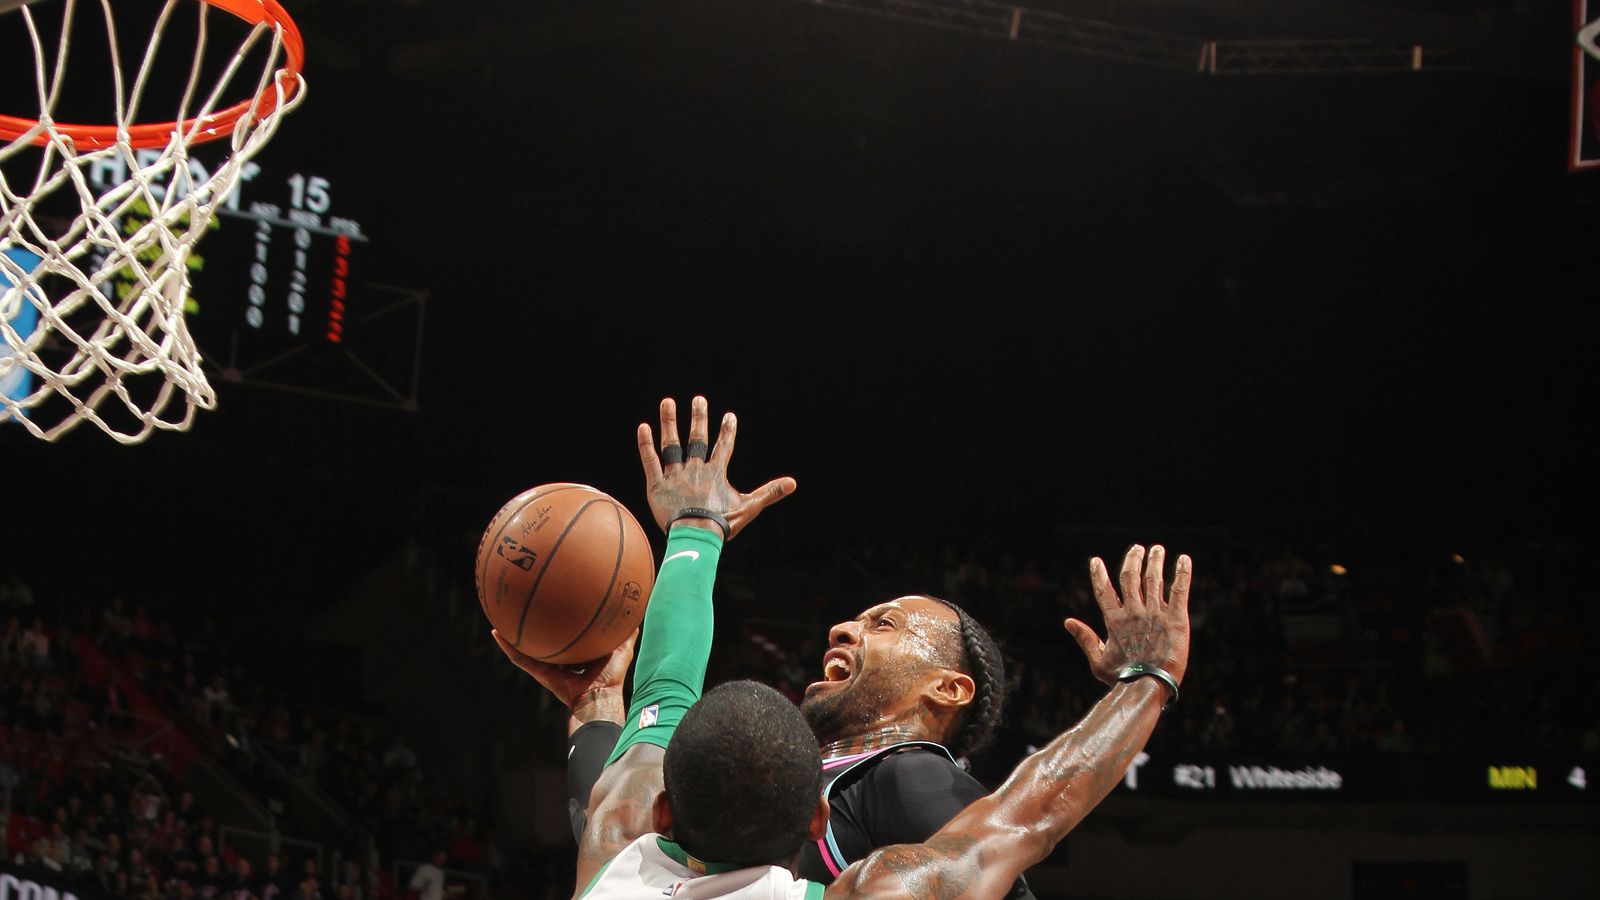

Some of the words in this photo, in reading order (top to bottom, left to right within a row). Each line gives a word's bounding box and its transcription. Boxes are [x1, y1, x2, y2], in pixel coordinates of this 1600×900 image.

[288, 173, 330, 213] 15
[294, 227, 311, 250] 0
[256, 242, 266, 263] 1
[295, 249, 306, 270] 1
[250, 262, 268, 285] 0
[248, 283, 265, 306] 0
[287, 291, 304, 314] 0
[246, 305, 263, 328] 0
[288, 313, 299, 335] 1
[1229, 764, 1343, 789] Whiteside
[1489, 765, 1536, 788] MIN
[1567, 765, 1586, 788] 4
